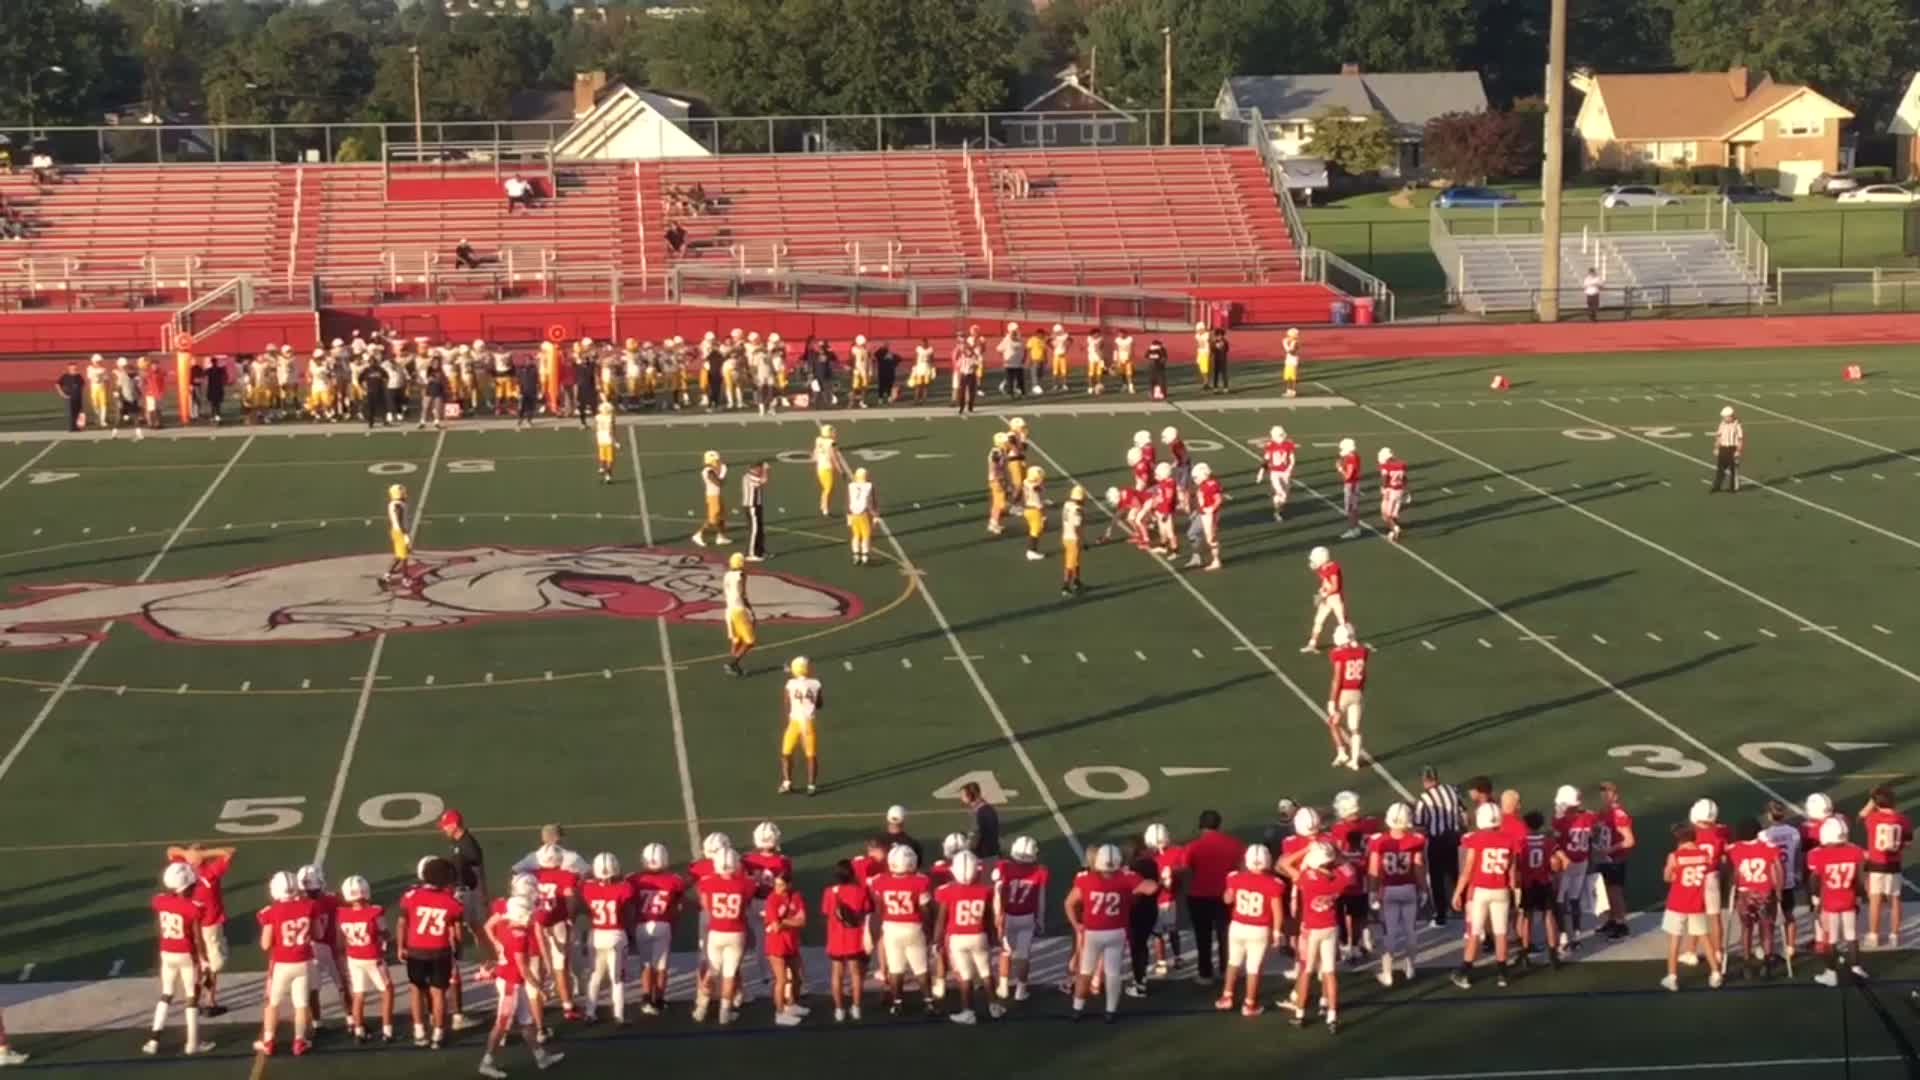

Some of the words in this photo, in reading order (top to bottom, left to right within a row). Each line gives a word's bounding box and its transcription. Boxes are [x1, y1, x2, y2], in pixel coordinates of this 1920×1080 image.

[793, 689, 815, 705] 44
[1383, 851, 1412, 876] 83
[1481, 847, 1511, 875] 65
[1739, 857, 1768, 883] 42
[1824, 862, 1856, 889] 37
[711, 892, 742, 919] 59
[883, 890, 915, 916] 53
[1008, 879, 1035, 905] 17
[1089, 891, 1122, 917] 72
[1235, 888, 1264, 918] 68
[415, 906, 448, 936] 73
[590, 899, 618, 926] 31
[955, 899, 986, 926] 69
[281, 916, 311, 947] 62
